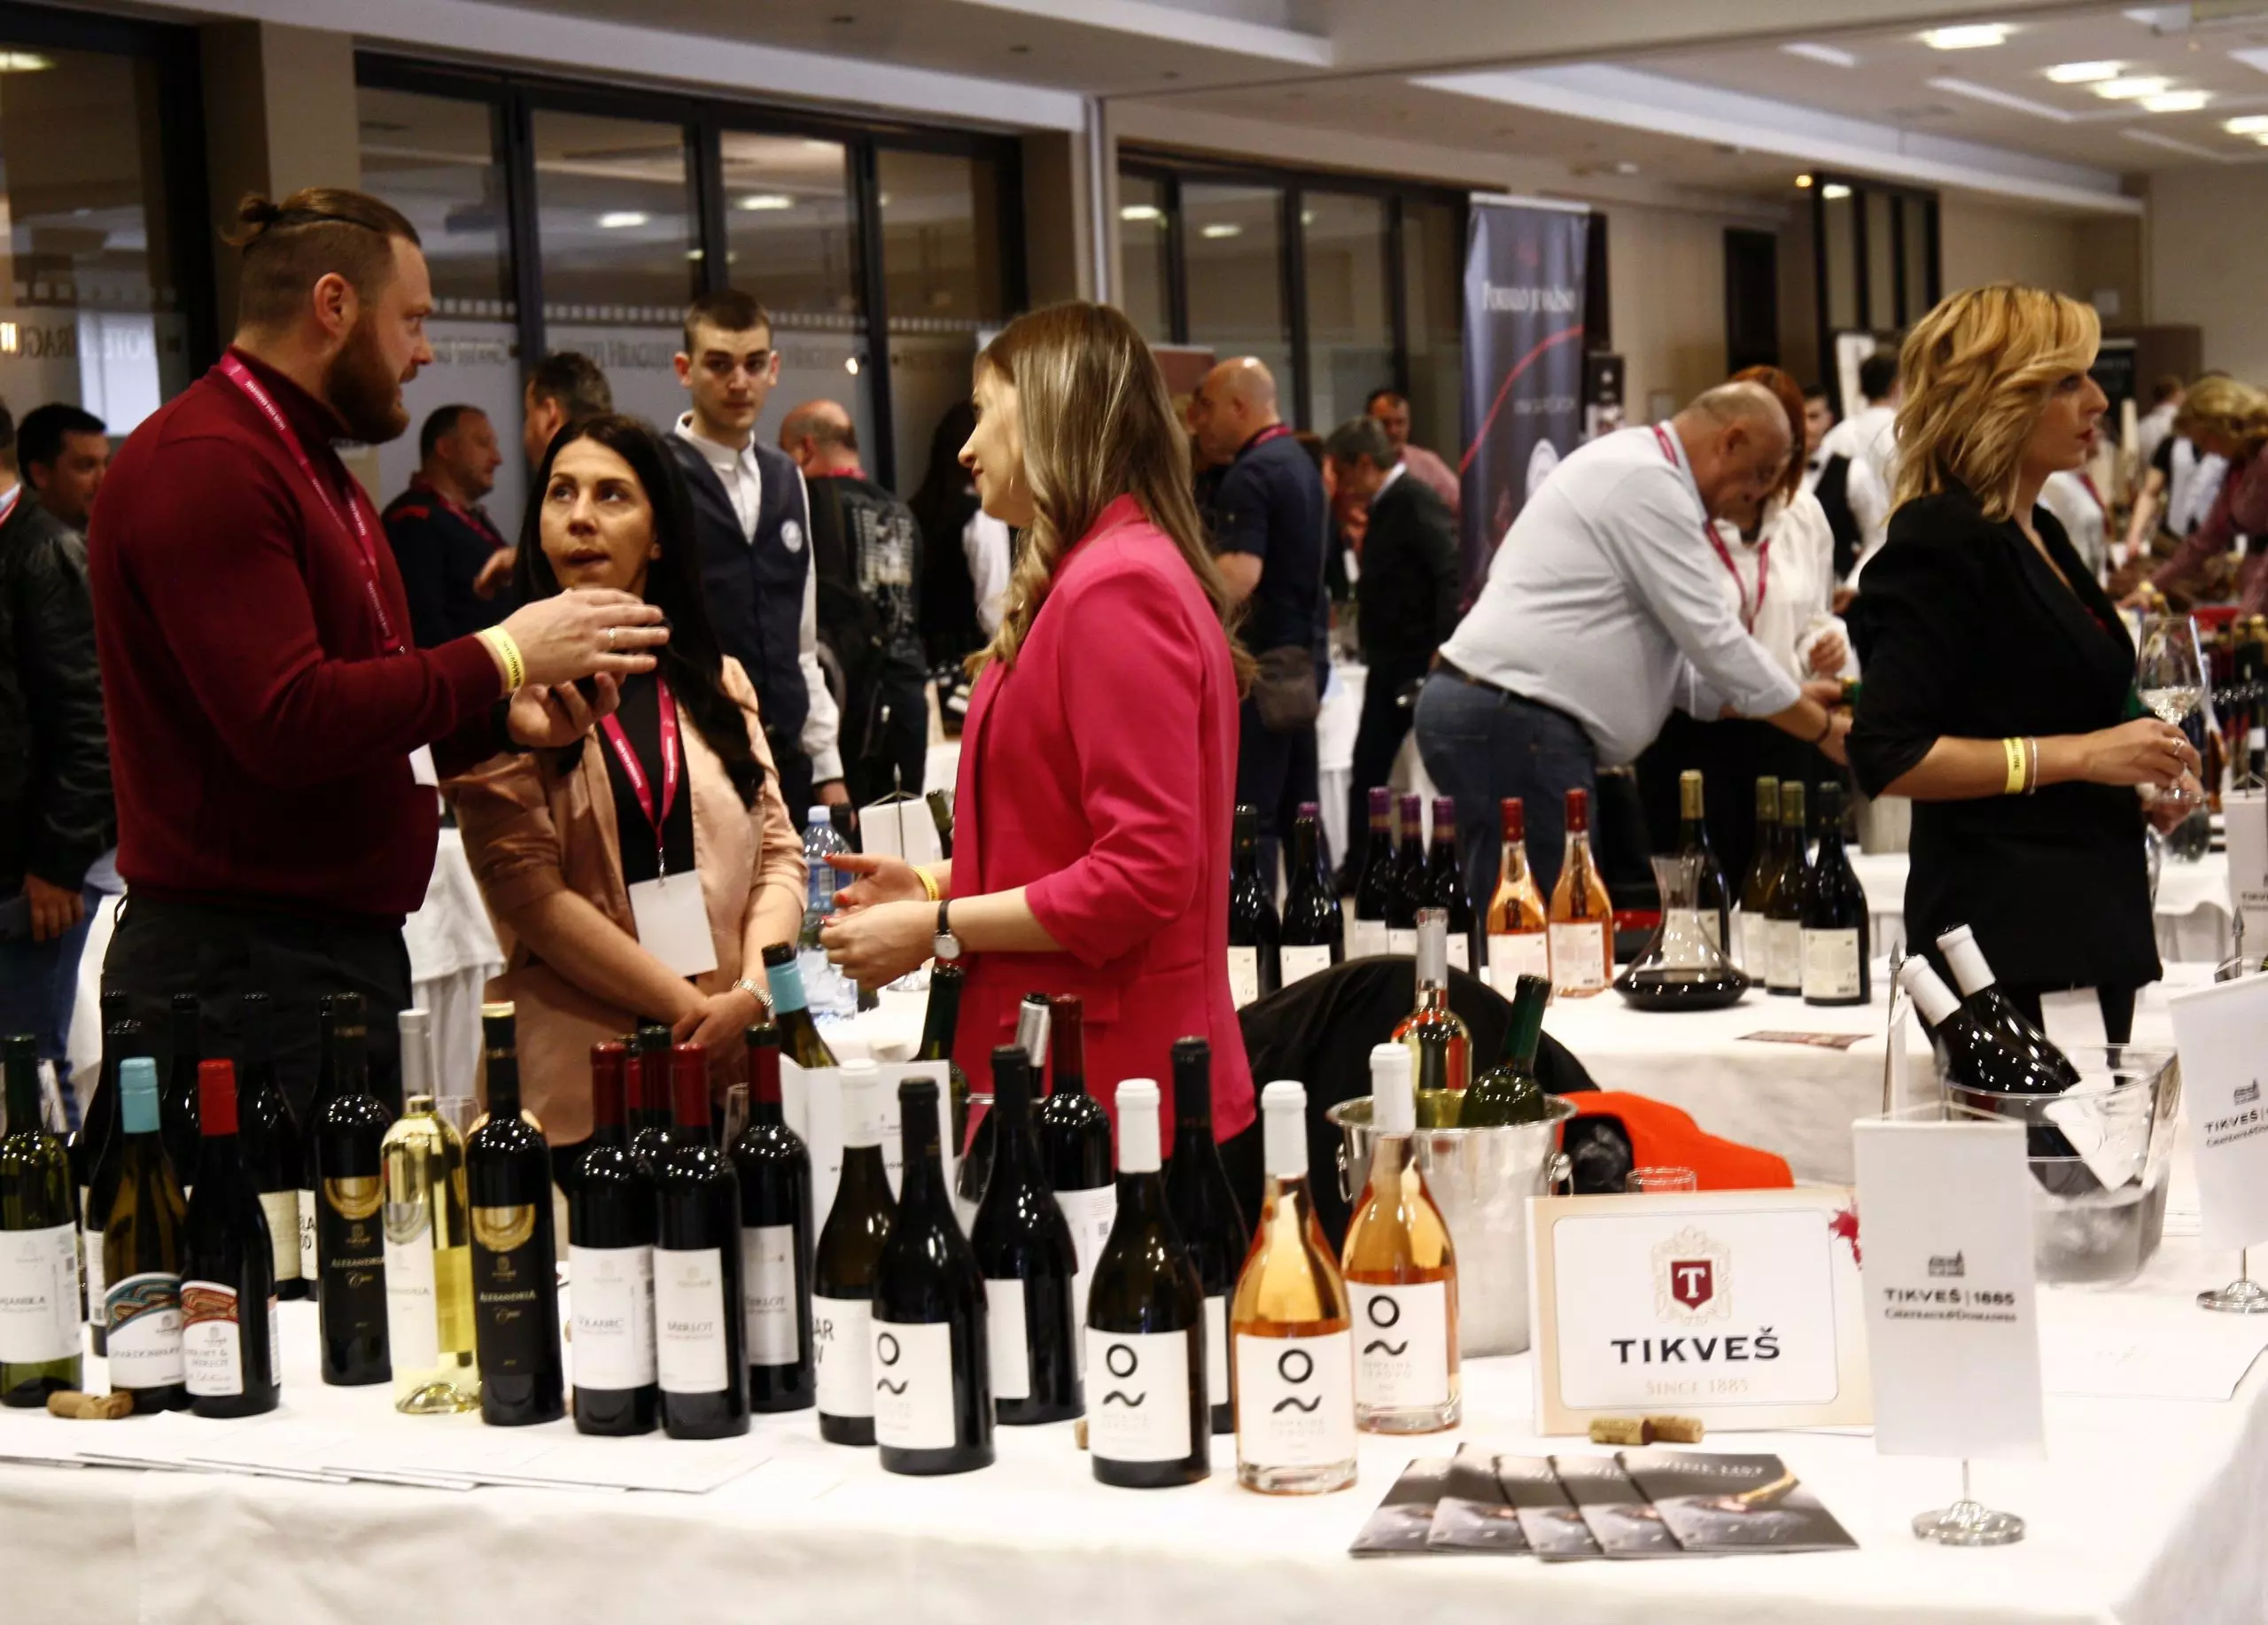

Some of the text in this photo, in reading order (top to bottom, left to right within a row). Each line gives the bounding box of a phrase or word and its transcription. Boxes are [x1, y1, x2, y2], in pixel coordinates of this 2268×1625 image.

[1677, 1266, 1706, 1299] T
[1611, 1326, 1781, 1364] TIKVEŠ
[1645, 1377, 1749, 1396] SINCE 1885
